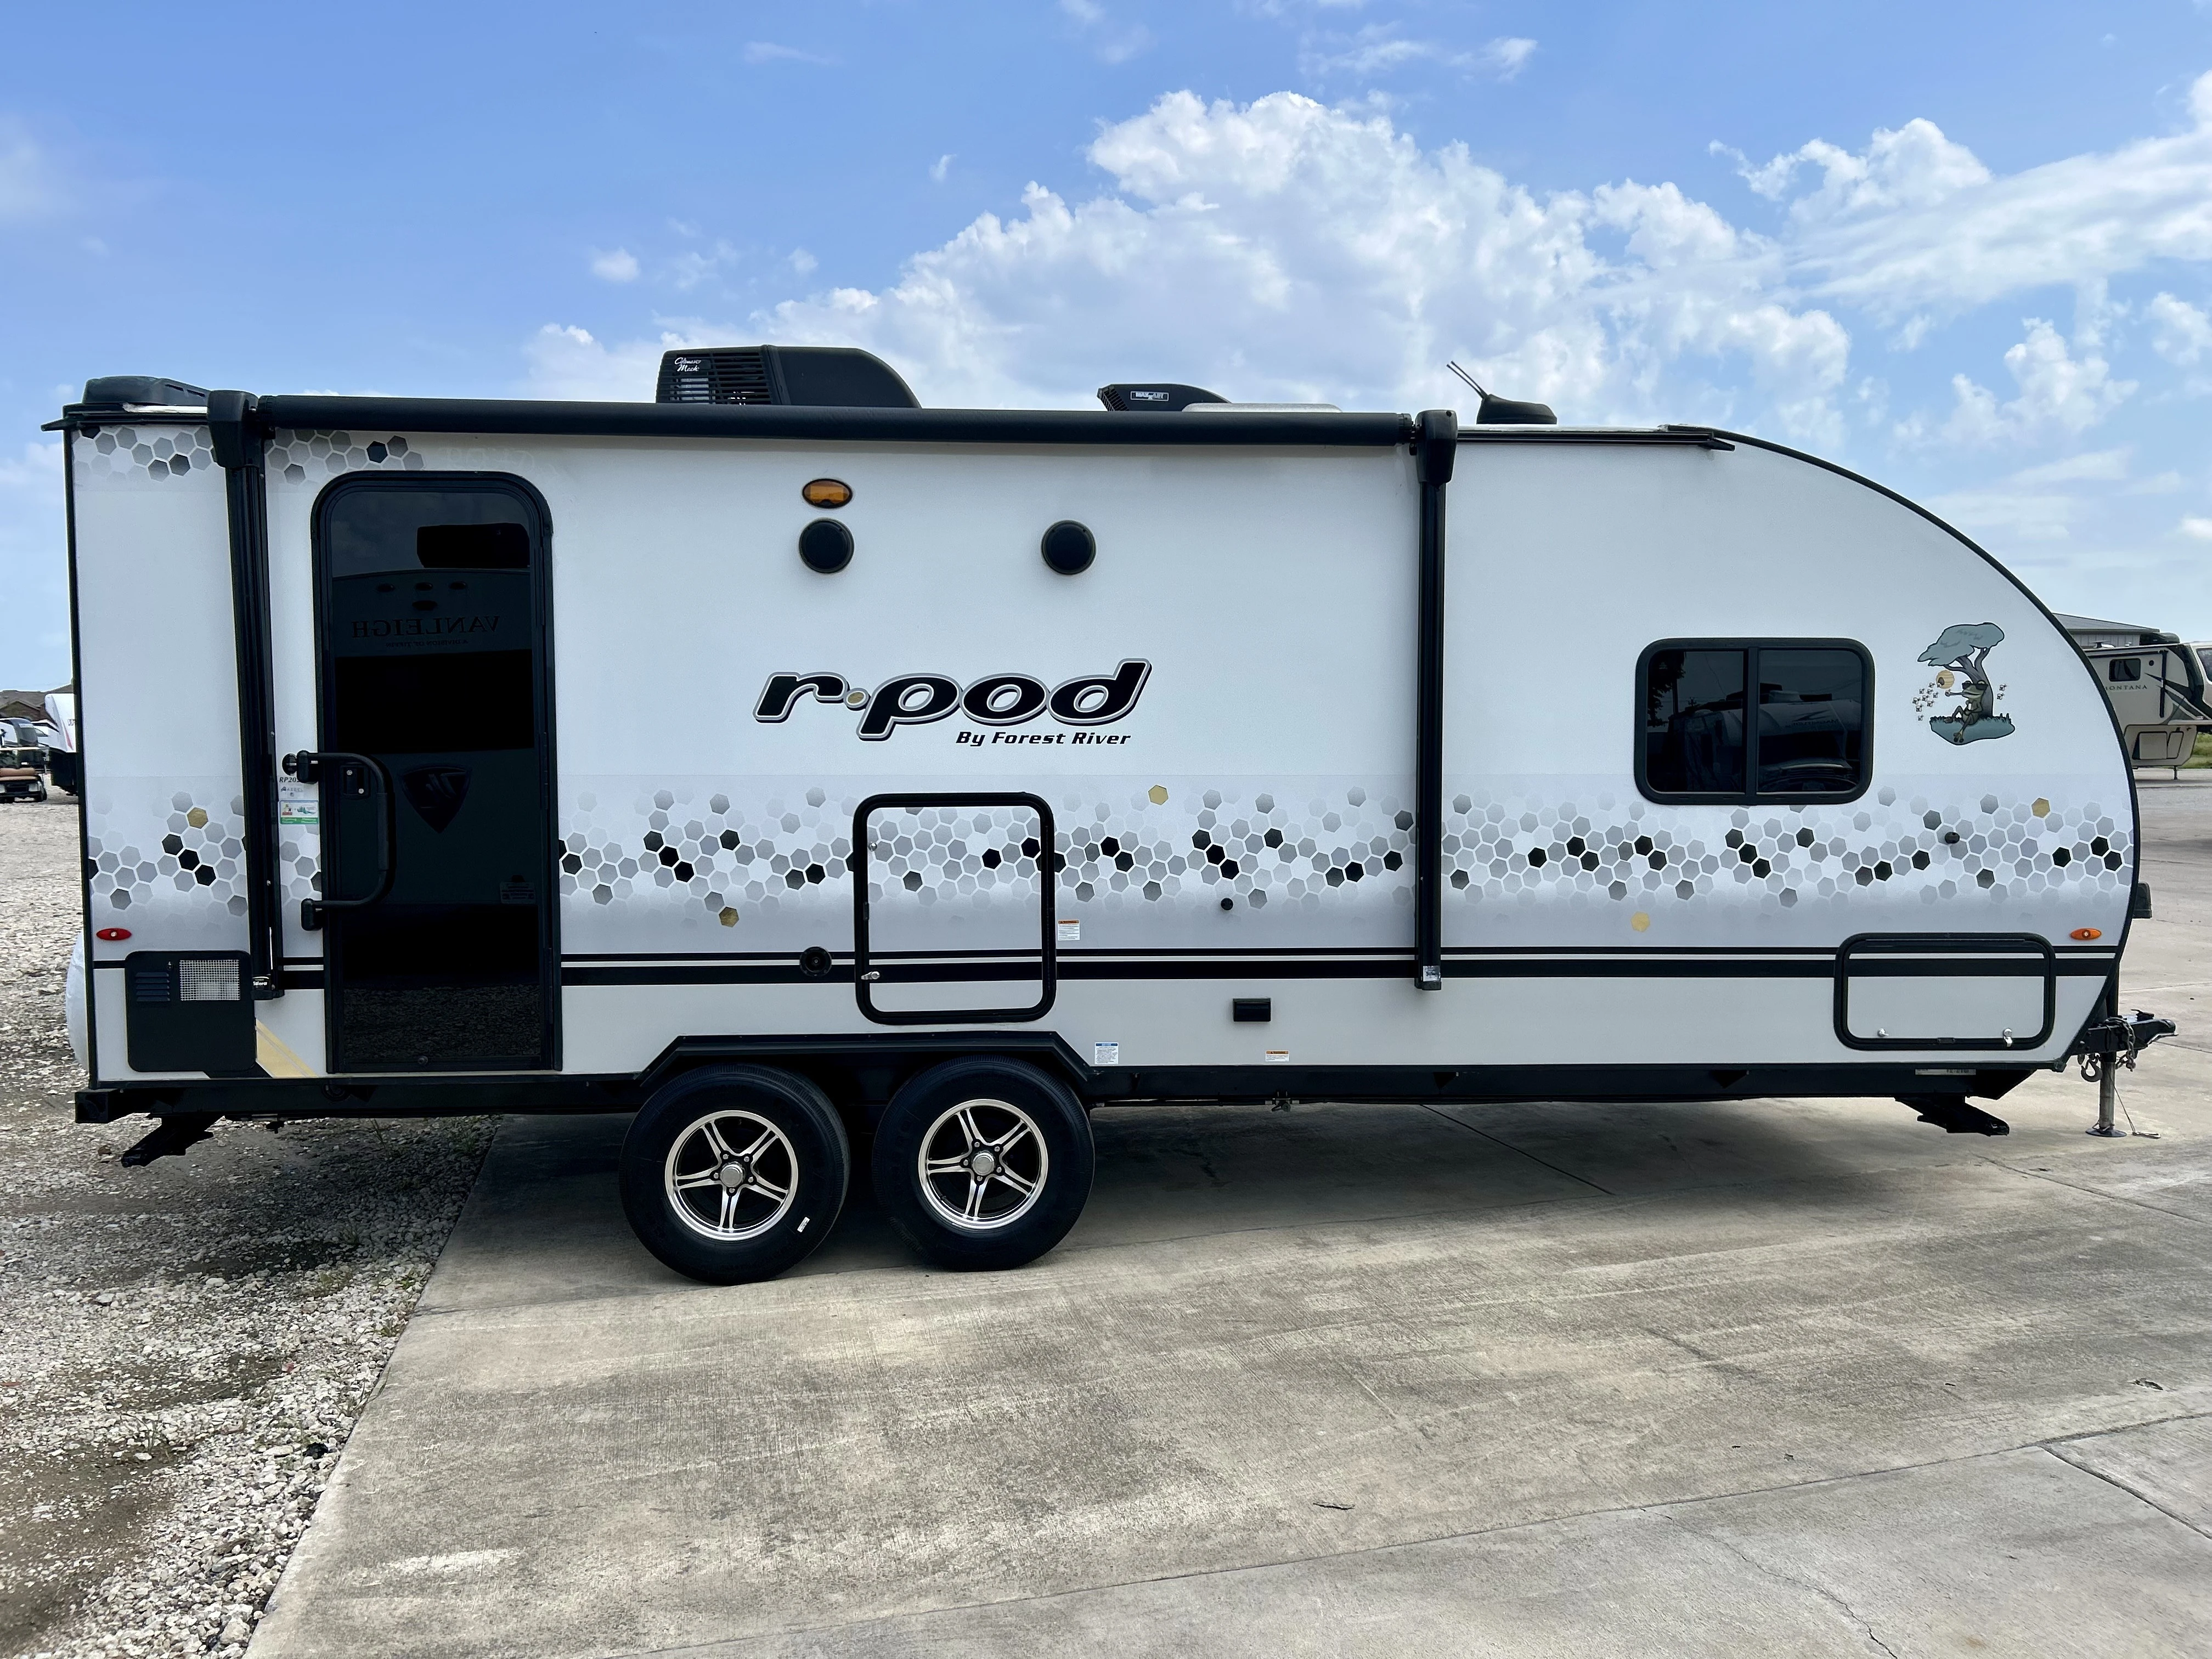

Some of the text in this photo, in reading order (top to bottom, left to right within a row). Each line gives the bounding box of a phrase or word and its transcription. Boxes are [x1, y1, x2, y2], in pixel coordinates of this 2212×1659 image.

[956, 731, 1131, 747] By Forest River
